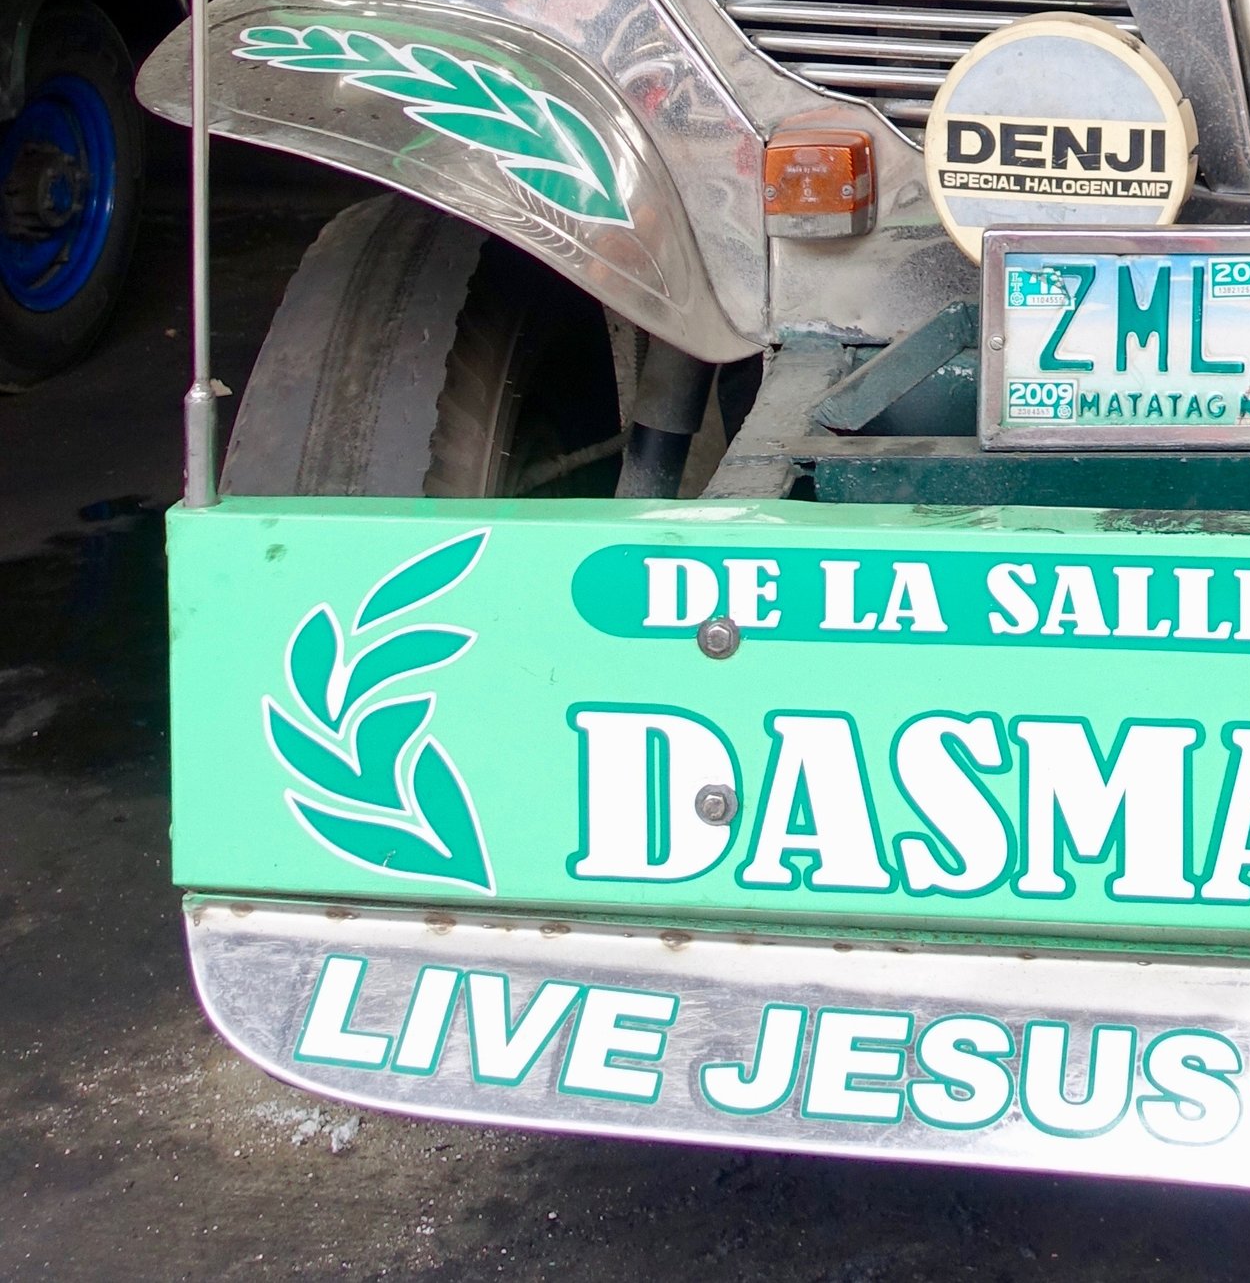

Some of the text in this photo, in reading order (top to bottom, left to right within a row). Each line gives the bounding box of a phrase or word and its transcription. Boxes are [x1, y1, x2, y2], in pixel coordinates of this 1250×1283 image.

[946, 119, 1166, 173] DENJI
[943, 172, 1169, 197] SPECIAL HALOGEN LAMP
[1039, 263, 1245, 375] ZML
[1009, 383, 1073, 405] 2009
[1079, 390, 1227, 421] MATATAG
[641, 556, 783, 629] DE
[819, 558, 949, 634] LA
[294, 952, 682, 1105] LIVE
[700, 1002, 1245, 1148] JESUS
